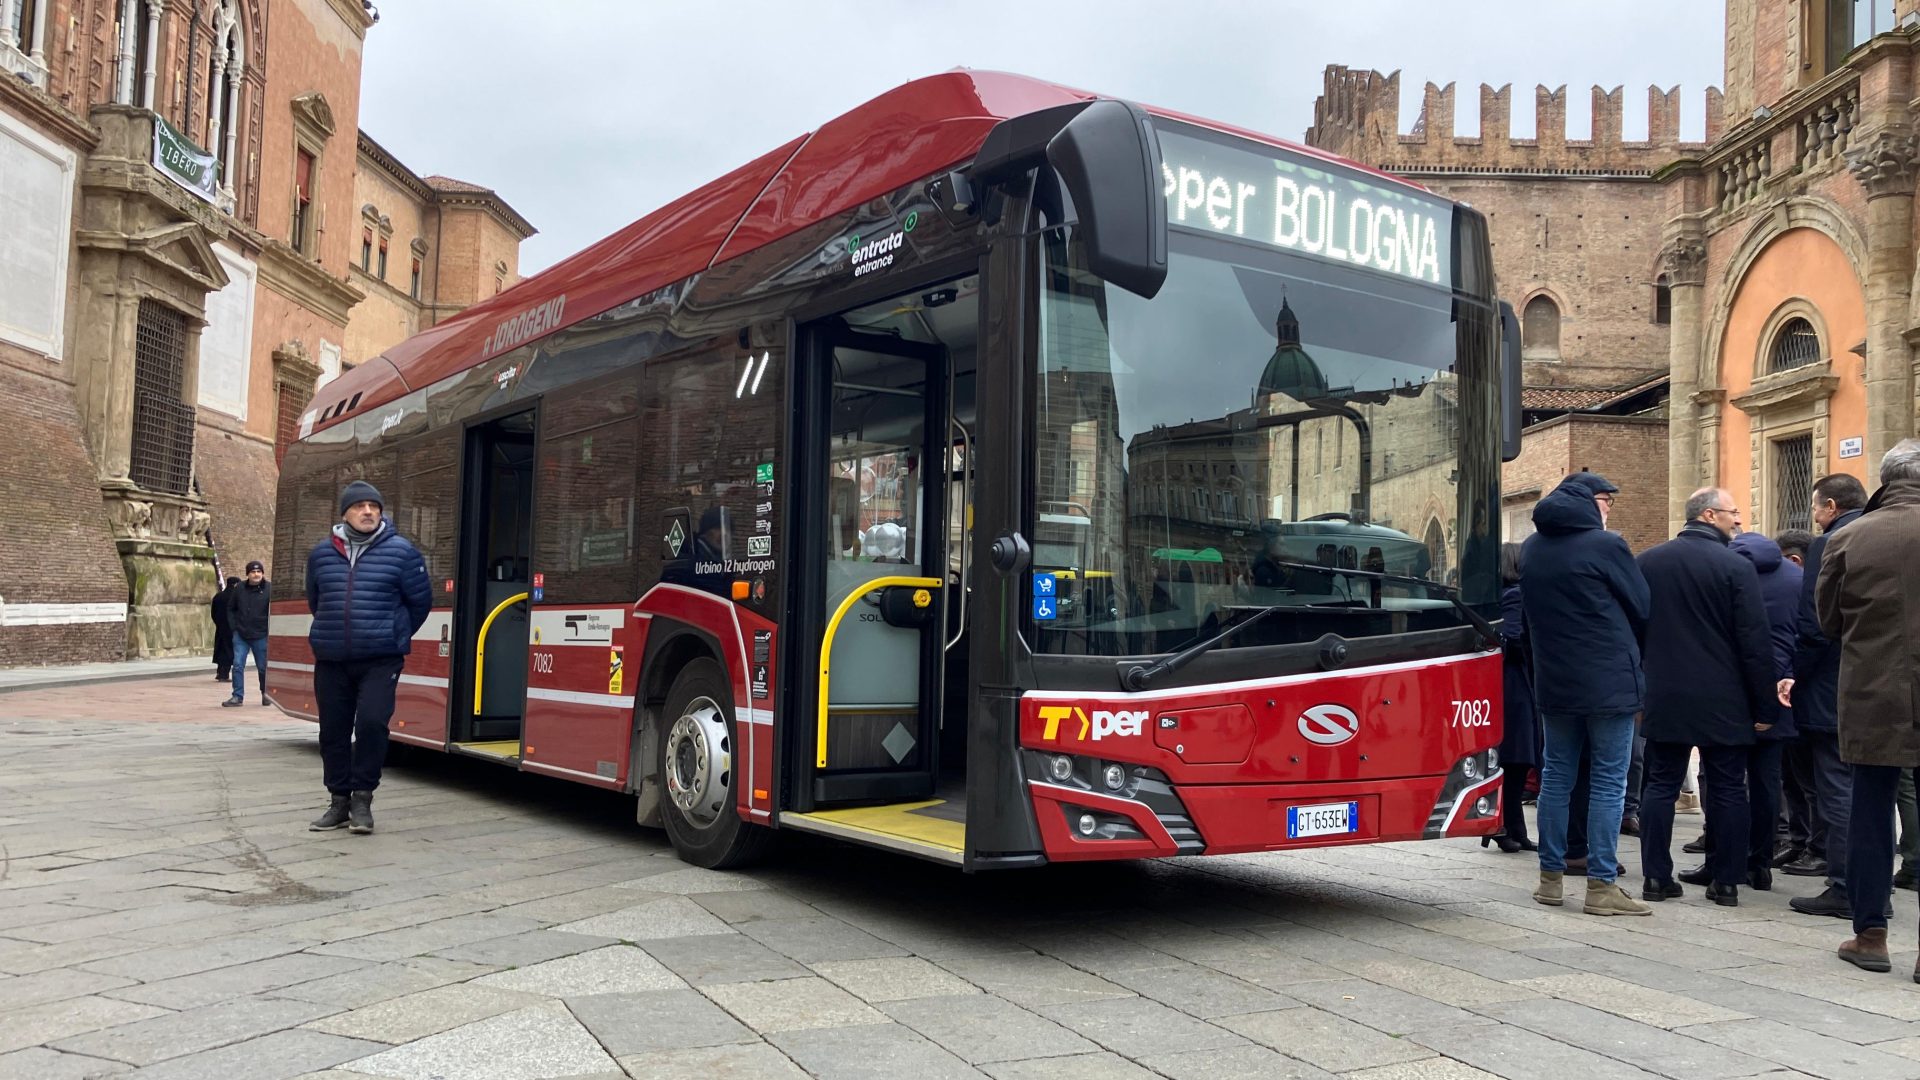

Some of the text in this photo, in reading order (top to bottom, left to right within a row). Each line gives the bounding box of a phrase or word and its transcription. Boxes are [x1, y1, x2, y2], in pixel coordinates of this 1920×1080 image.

[160, 142, 197, 177] LIBERO
[1273, 176, 1440, 283] BOLOGNA
[851, 231, 903, 264] entrata
[854, 254, 894, 277] entrance
[493, 294, 566, 353] IDROGENO
[695, 558, 775, 575] Urbino 12 hydrogen
[533, 652, 553, 673] 7082
[1451, 699, 1491, 728] 7082
